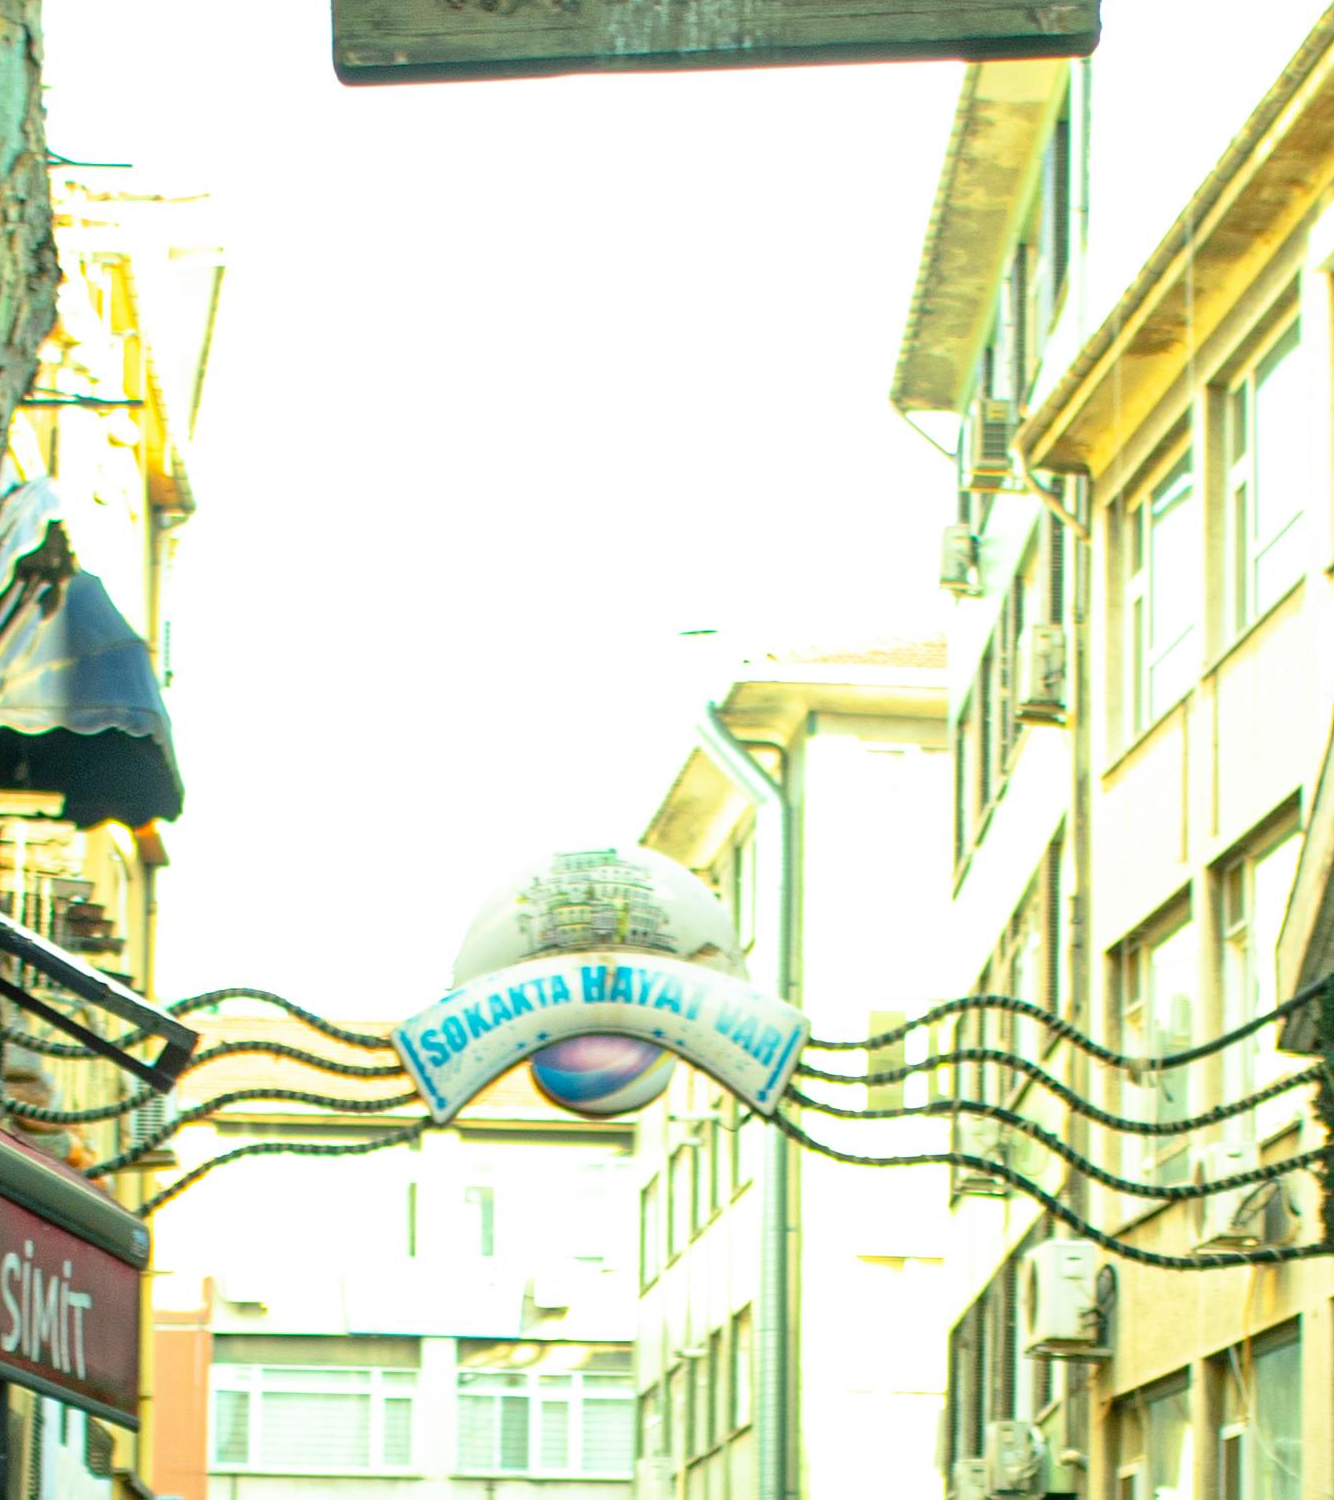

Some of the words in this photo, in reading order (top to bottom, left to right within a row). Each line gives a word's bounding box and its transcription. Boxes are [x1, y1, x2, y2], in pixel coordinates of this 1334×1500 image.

[419, 974, 572, 1069] SOKAKTA
[580, 965, 711, 1022] HAYAT
[712, 997, 783, 1068] VAR
[0, 1240, 93, 1381] SİMİT
